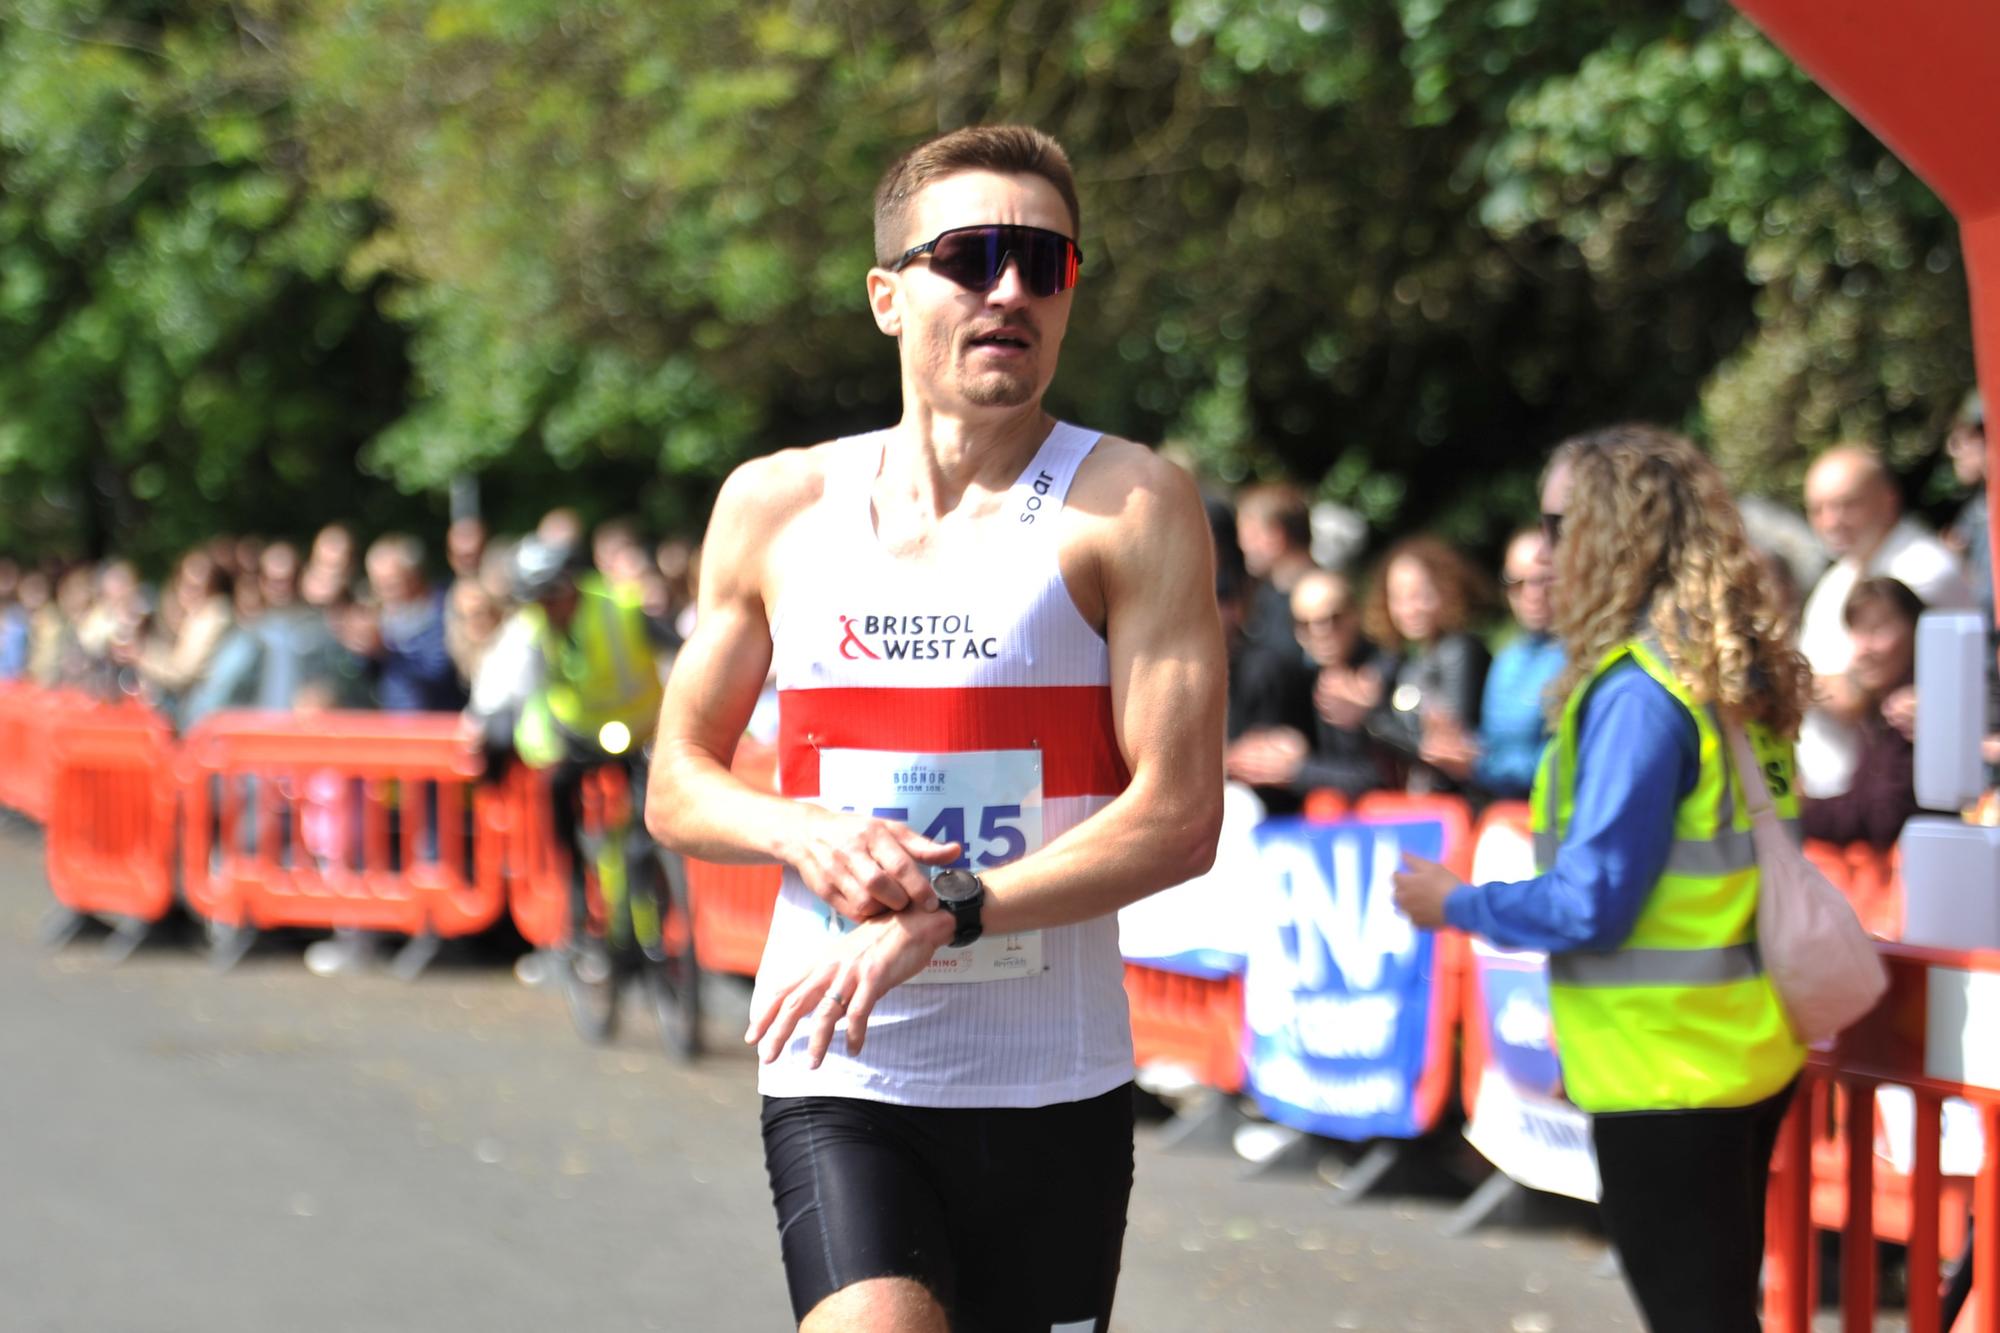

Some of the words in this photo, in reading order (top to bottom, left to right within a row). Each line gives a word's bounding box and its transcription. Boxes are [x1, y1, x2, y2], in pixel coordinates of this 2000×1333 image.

[1019, 469, 1054, 525] soar
[864, 614, 974, 635] BRISTOL
[882, 639, 956, 660] WEST
[962, 637, 998, 660] AC
[893, 772, 946, 785] BOGNOR
